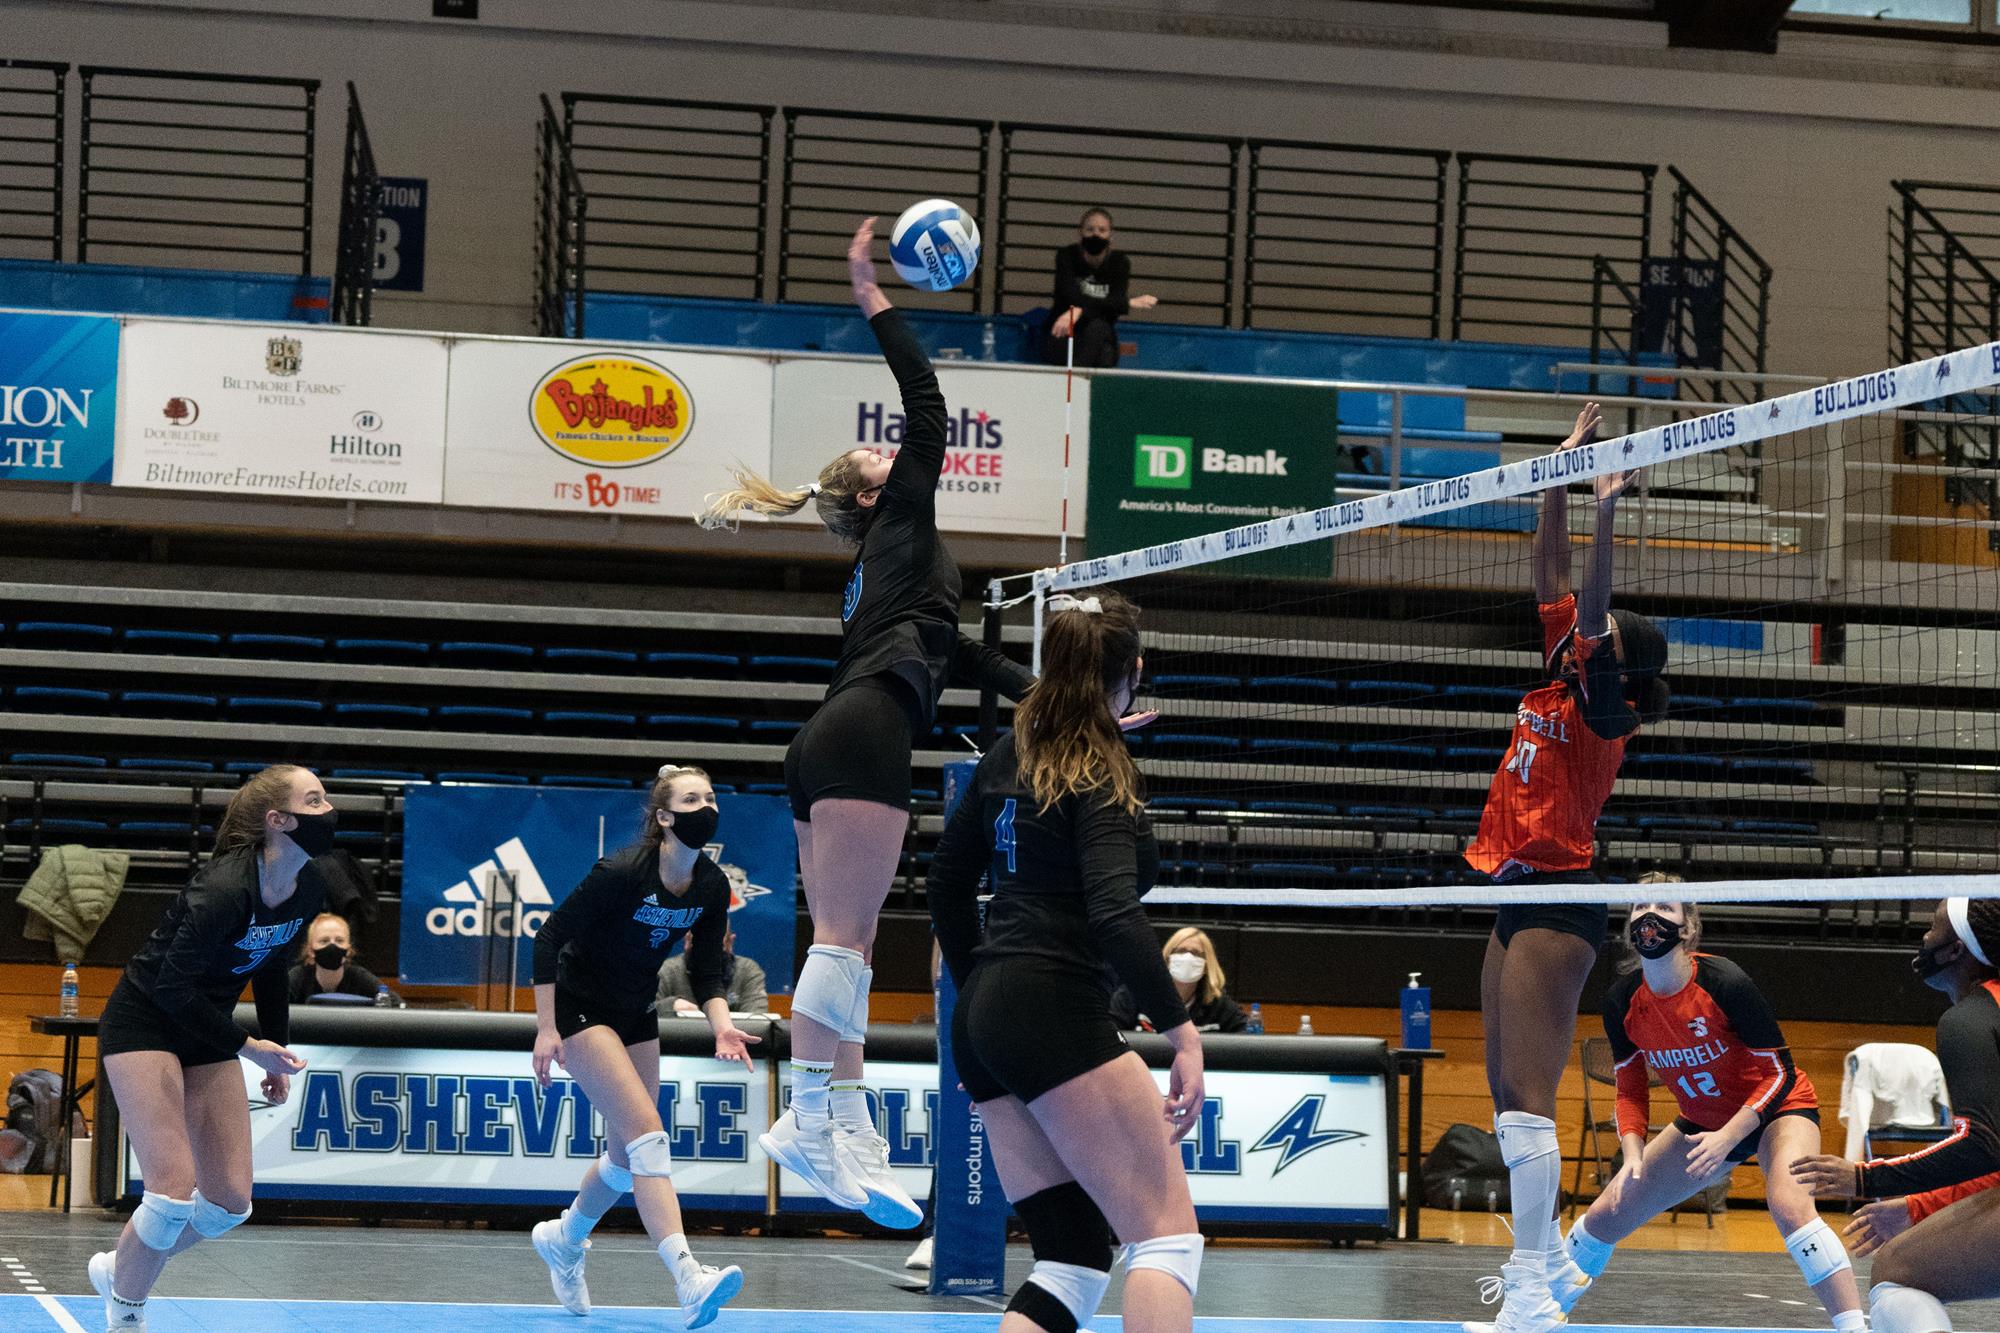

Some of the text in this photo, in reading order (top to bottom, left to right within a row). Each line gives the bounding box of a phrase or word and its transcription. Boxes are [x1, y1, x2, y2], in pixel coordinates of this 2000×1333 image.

[379, 185, 421, 208] TION
[372, 217, 401, 281] B
[1649, 264, 1715, 288] SETION
[257, 394, 307, 407] HOTELS
[1814, 370, 1897, 416] BULLDOGS
[329, 434, 402, 458] Hilton
[1663, 411, 1736, 453] BULLDOGS
[145, 462, 408, 495] BiltmoreFarmsHotels.com
[1140, 444, 1289, 479] TD Bank
[1531, 446, 1595, 483] BULLDOGS
[554, 482, 583, 500] IT'S
[623, 486, 661, 504] TIME!
[1119, 498, 1174, 513] America's
[1175, 501, 1204, 514] Most
[1205, 502, 1269, 517] Convenient
[994, 798, 1017, 873] 4
[425, 899, 552, 939] adida
[1648, 1038, 1730, 1070] AMPBELL
[1676, 1070, 1722, 1099] 12
[292, 1069, 748, 1163] ASHEVILE
[965, 1135, 983, 1206] imports
